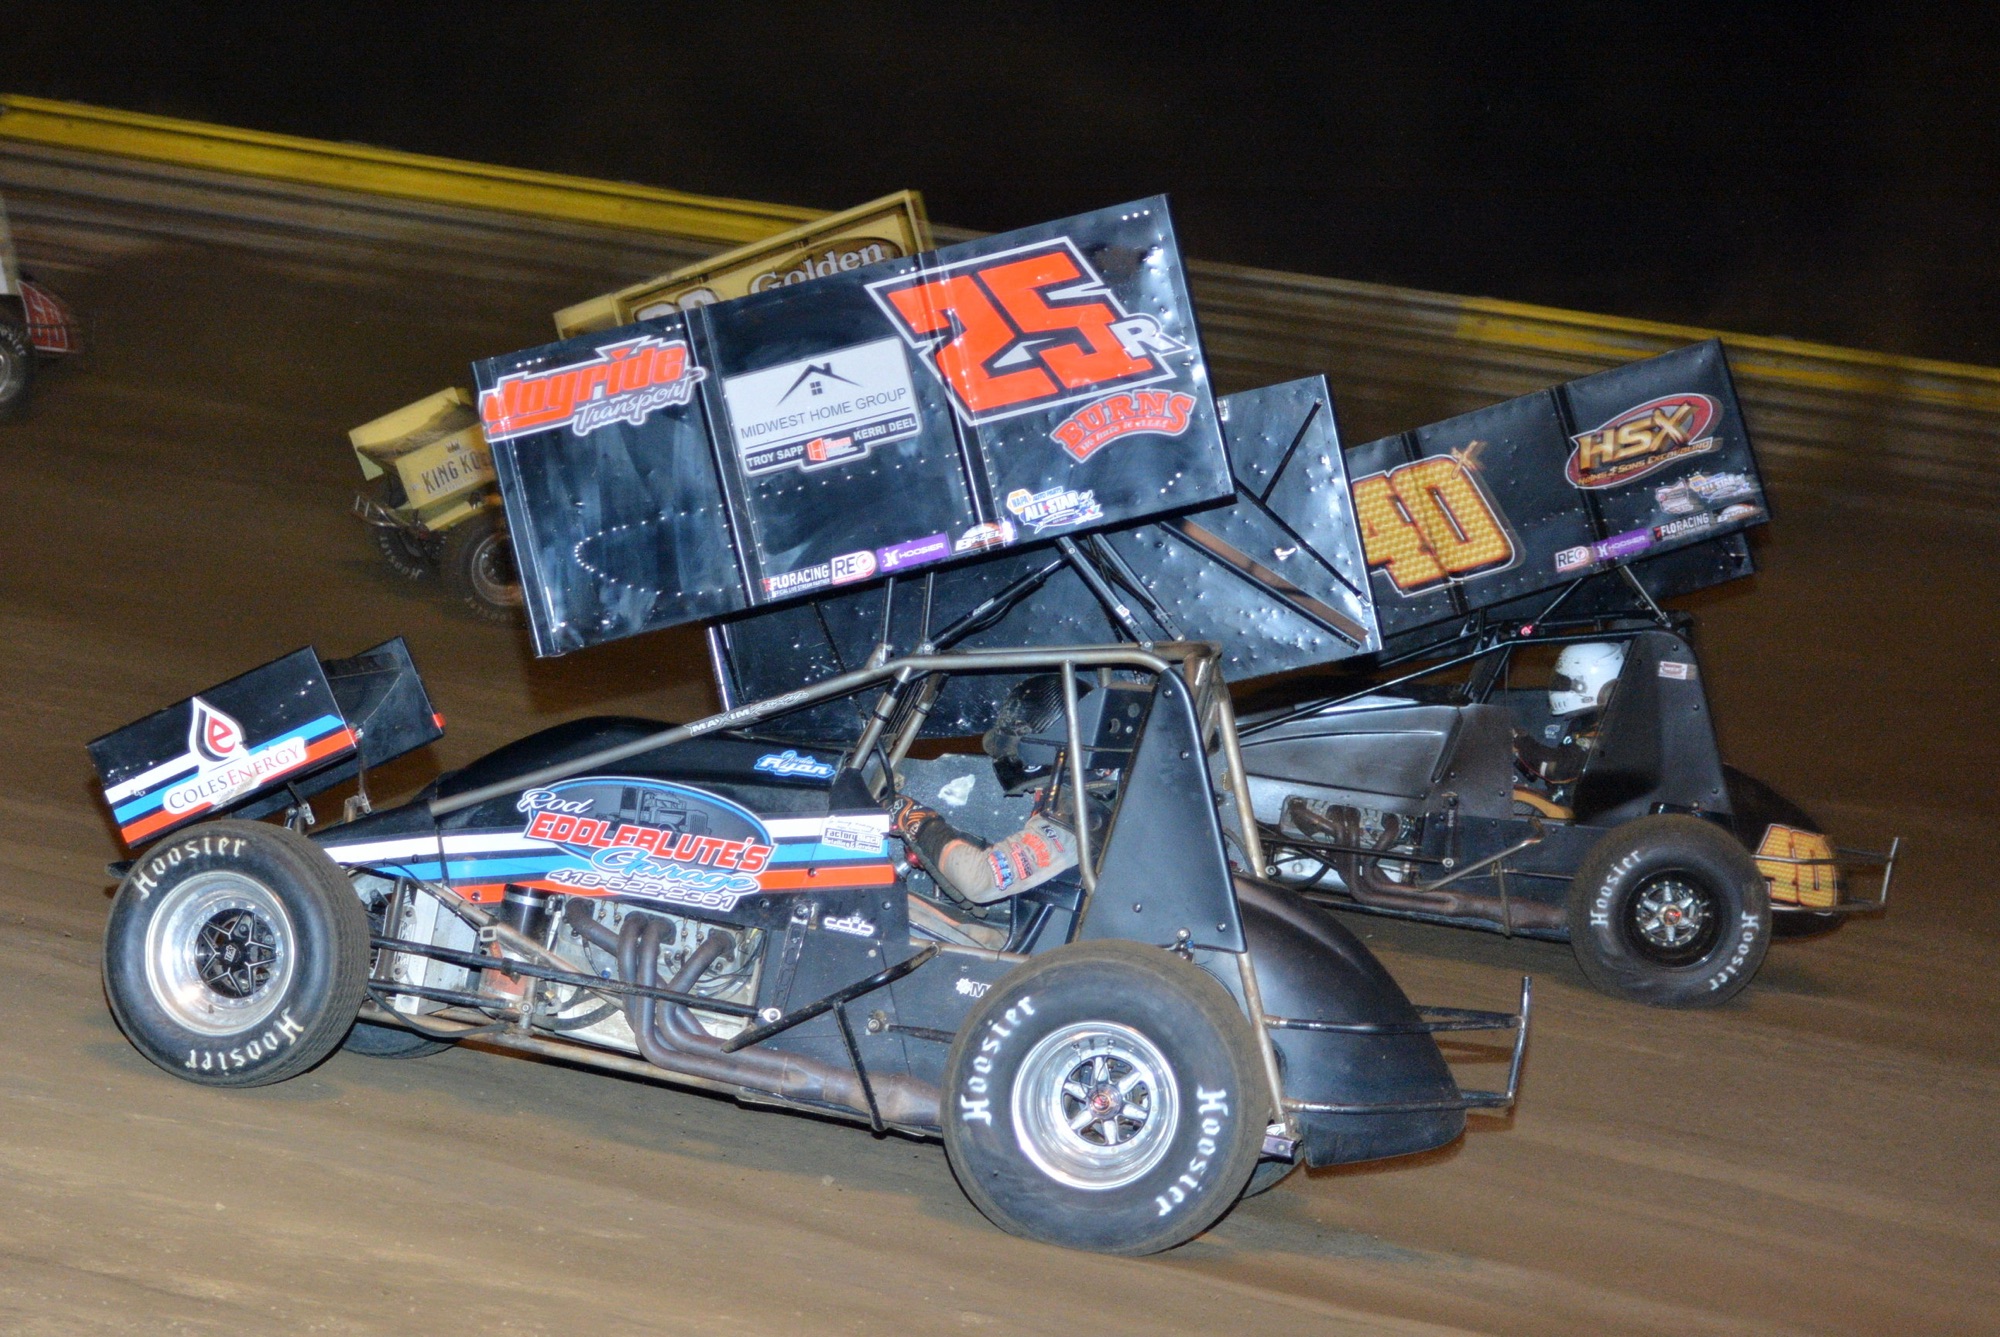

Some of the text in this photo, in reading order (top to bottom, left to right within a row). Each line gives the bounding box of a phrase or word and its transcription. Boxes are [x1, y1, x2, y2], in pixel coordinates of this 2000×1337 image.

[750, 243, 886, 293] Golden
[740, 387, 907, 440] MIDWEST HOME GROUP
[853, 418, 916, 441] KERRI DEEL
[1055, 392, 1192, 448] BURNS
[1579, 402, 1691, 470] HSX
[421, 460, 459, 494] KING
[746, 446, 804, 467] TROY SAPP
[1024, 502, 1049, 521] ALL
[1046, 492, 1079, 514] STAR
[1661, 513, 1709, 537] FLORACING
[899, 542, 944, 559] HOOSIER
[770, 564, 829, 591] FLORACING
[760, 757, 828, 774] Ryan
[521, 790, 594, 814] Rod
[528, 812, 771, 872] EDDLEBLUTE'S
[131, 836, 247, 901] Hoosier
[549, 869, 735, 908] 419-522-2361
[601, 848, 754, 891] Garage
[1590, 850, 1642, 929] Hoosier
[1709, 910, 1760, 992] Hoosier
[184, 1006, 304, 1075] Hoosier
[961, 996, 1036, 1127] Hoosier
[1155, 1086, 1230, 1217] Hoosier
